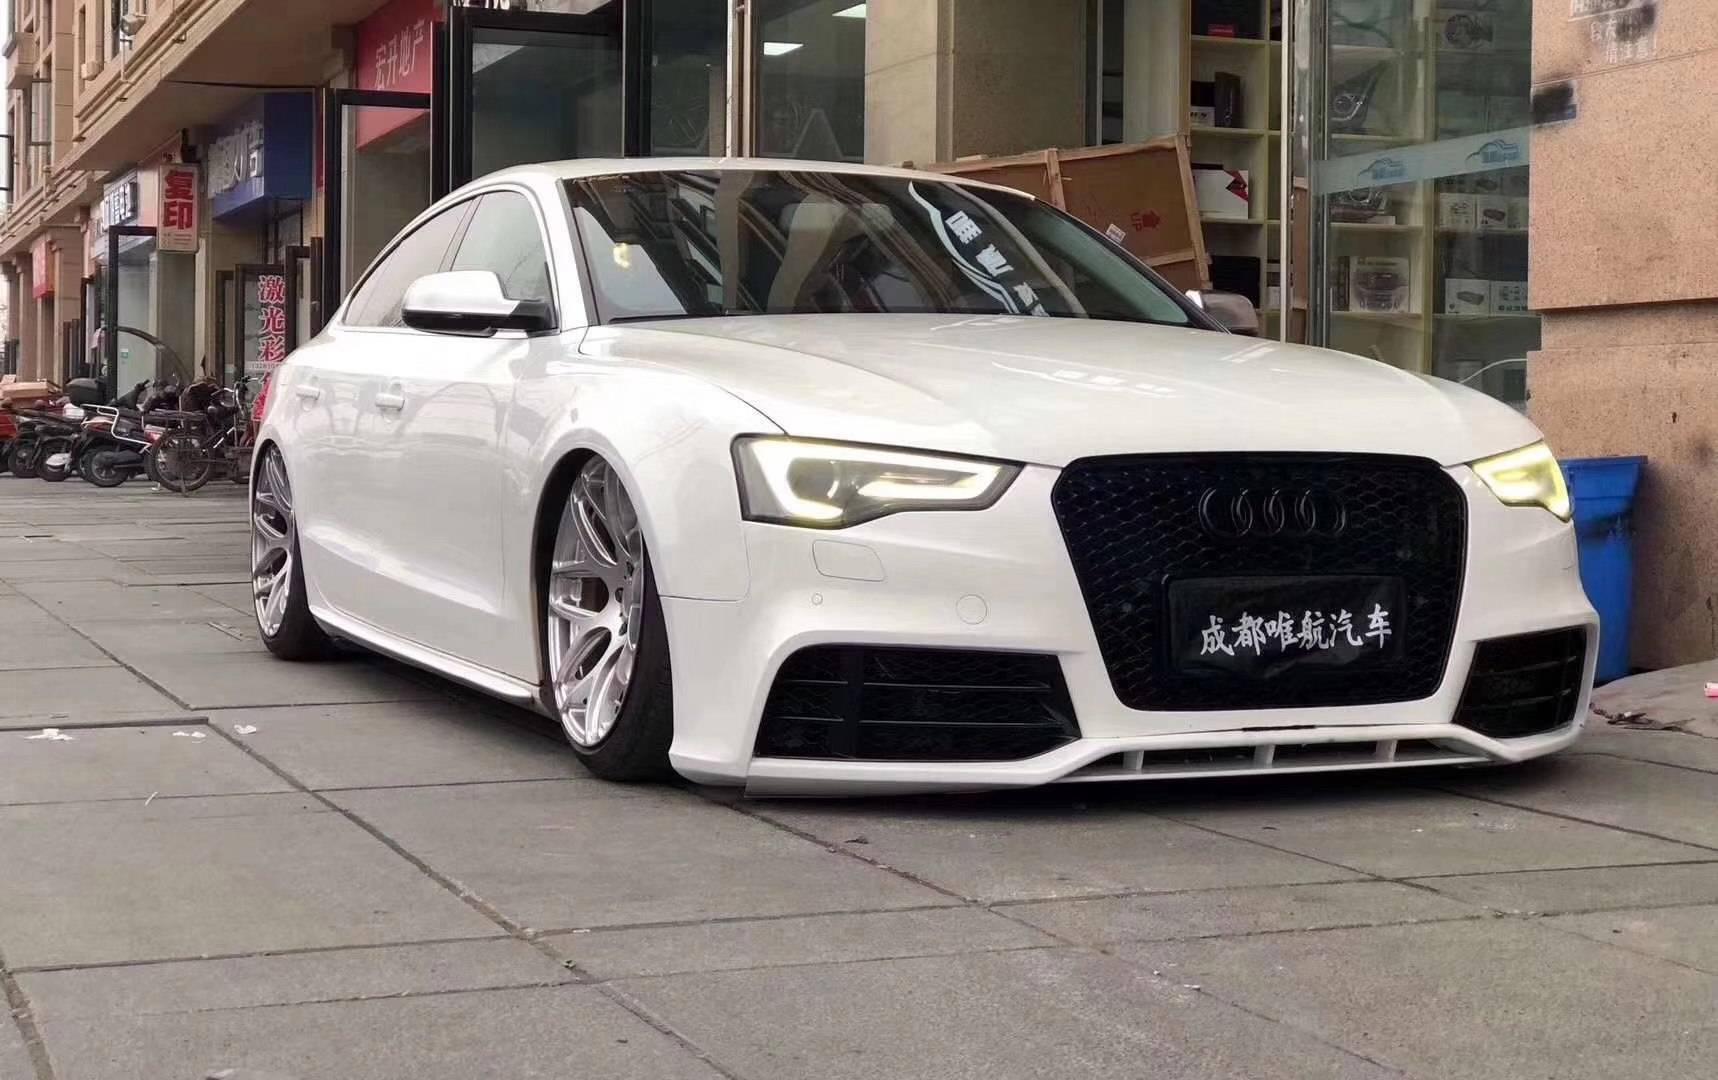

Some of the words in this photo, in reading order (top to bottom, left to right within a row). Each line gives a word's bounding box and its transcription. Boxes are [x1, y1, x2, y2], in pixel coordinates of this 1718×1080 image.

[374, 18, 426, 91] 宏升地产
[163, 169, 194, 230] 复印
[1200, 602, 1393, 657] 成都唯航汽车
